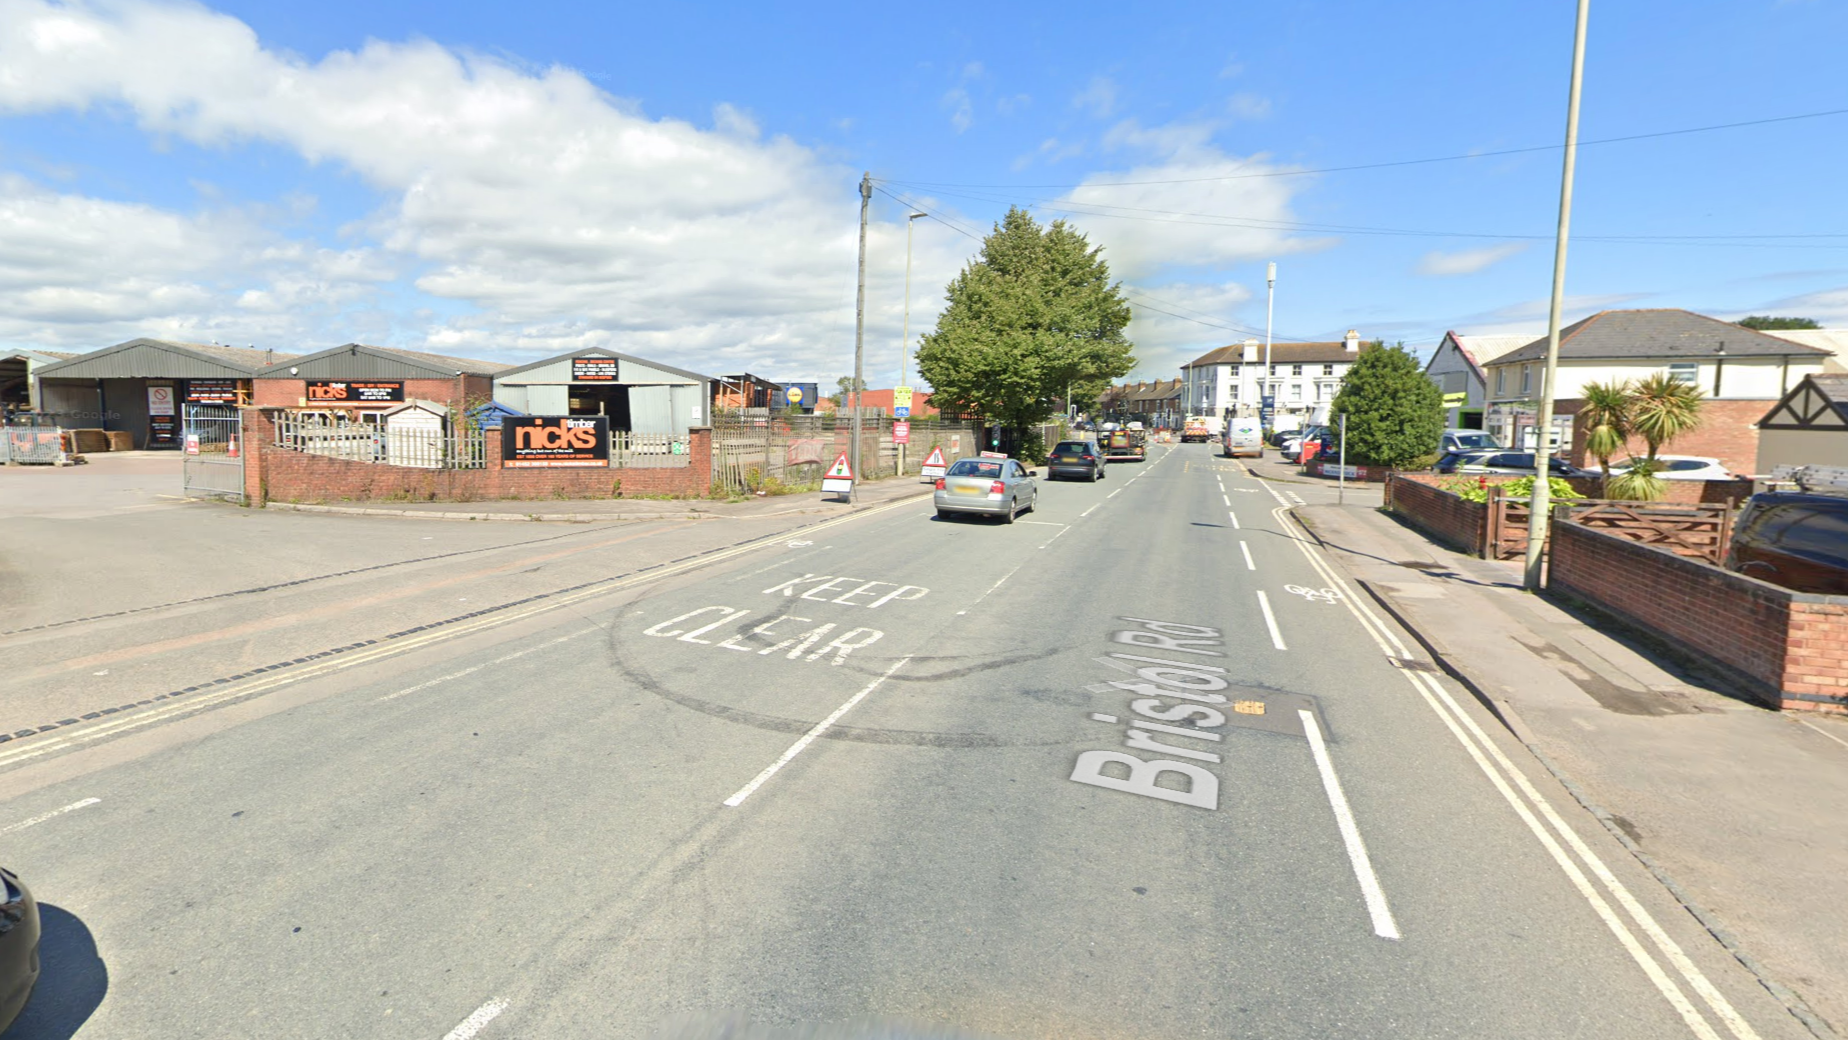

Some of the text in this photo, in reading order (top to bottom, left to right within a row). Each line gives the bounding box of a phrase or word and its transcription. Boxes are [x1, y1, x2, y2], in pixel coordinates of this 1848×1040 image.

[309, 383, 348, 398] nicks
[515, 418, 596, 449] nicks
[567, 419, 596, 428] timber
[762, 573, 931, 608] KEEP
[643, 605, 885, 667] CLEAR
